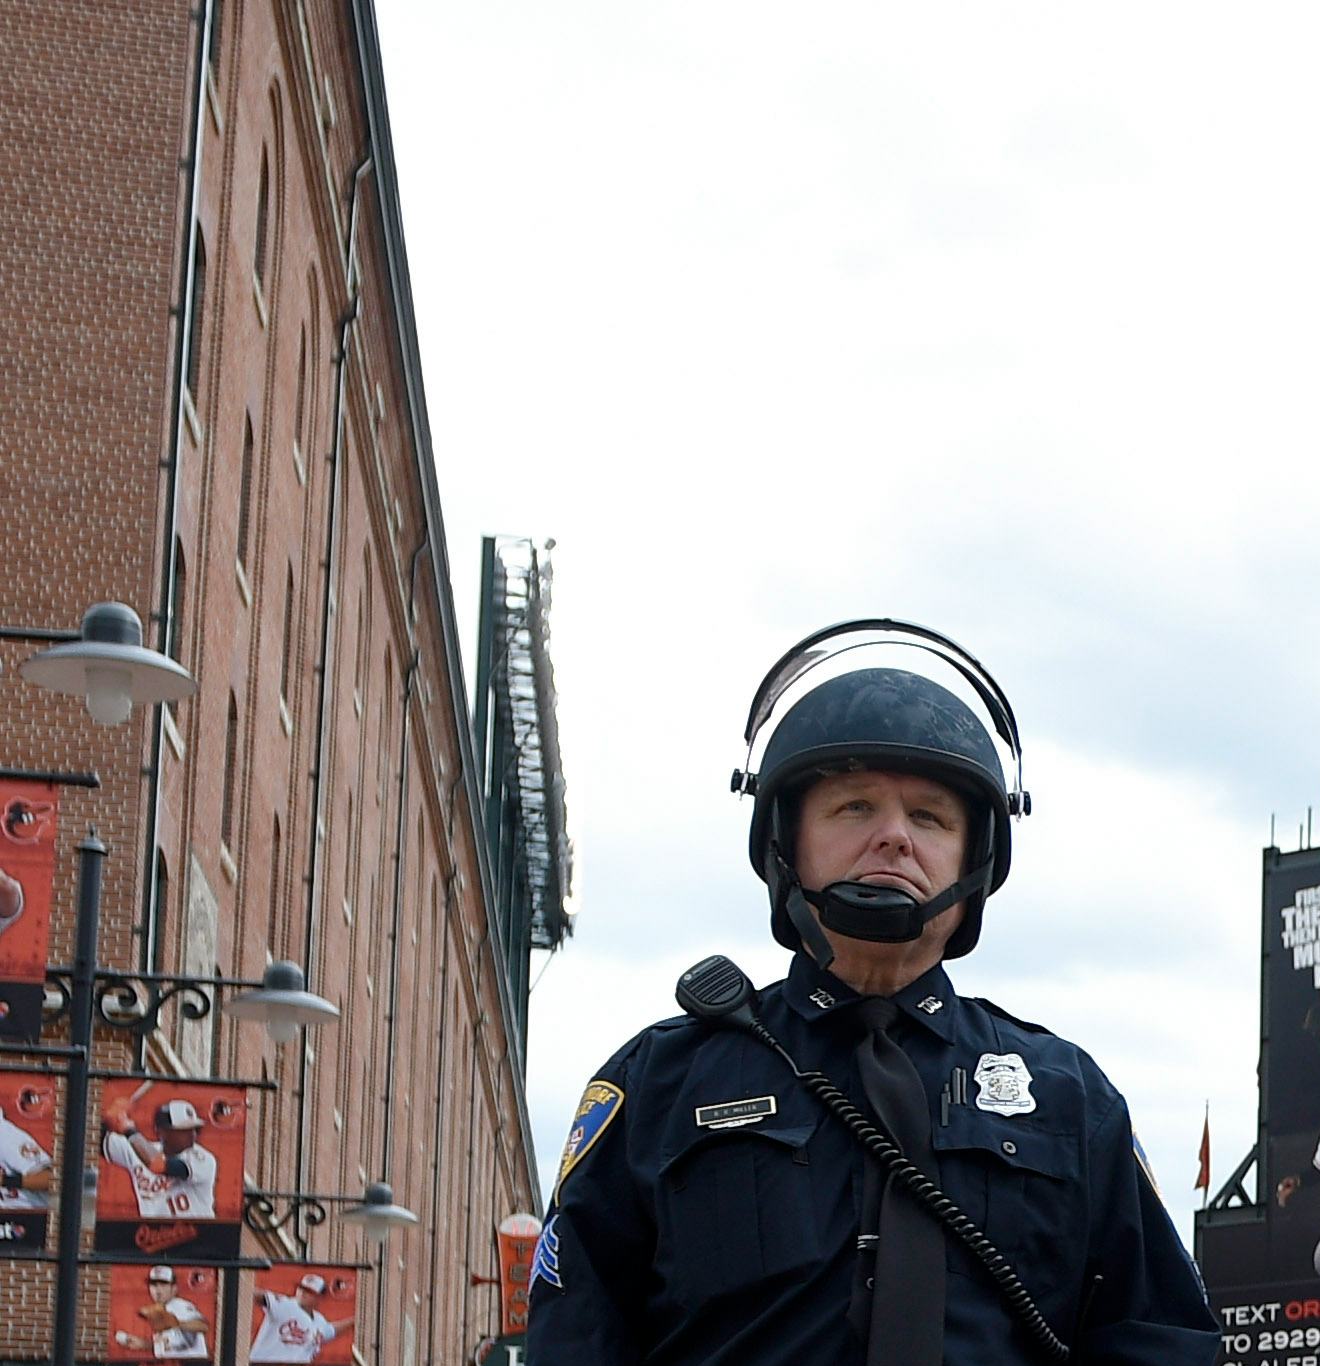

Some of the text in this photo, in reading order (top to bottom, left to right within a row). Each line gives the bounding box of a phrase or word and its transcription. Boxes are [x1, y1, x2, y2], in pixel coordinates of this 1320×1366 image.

[1281, 926, 1316, 949] THEN
[165, 1192, 191, 1217] 10
[1221, 1303, 1281, 1327] TEXT
[1221, 1333, 1251, 1354] TO
